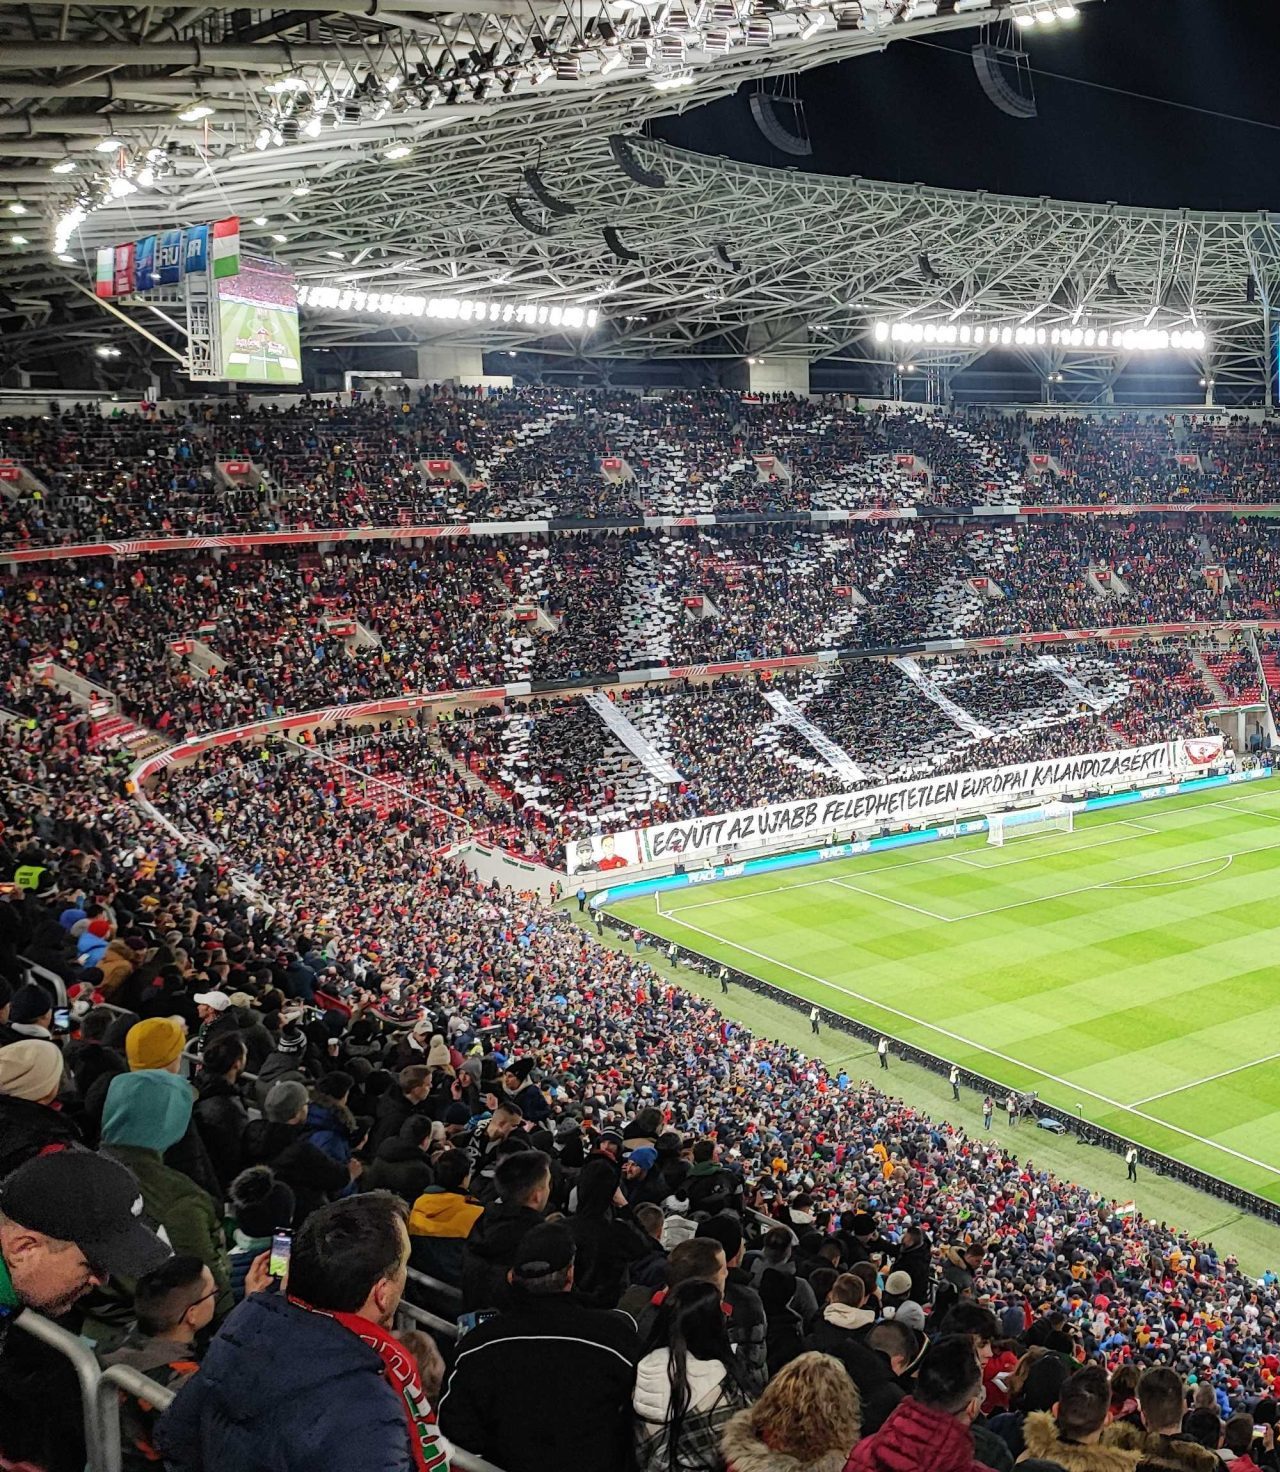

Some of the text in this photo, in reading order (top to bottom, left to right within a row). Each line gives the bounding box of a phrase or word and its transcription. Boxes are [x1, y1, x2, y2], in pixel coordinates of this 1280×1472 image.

[653, 748, 1166, 857] EGYÜTT AZ ÚJABB FELEDHETETLEN EURÓPAI KALANDOZÁSÉRT!
